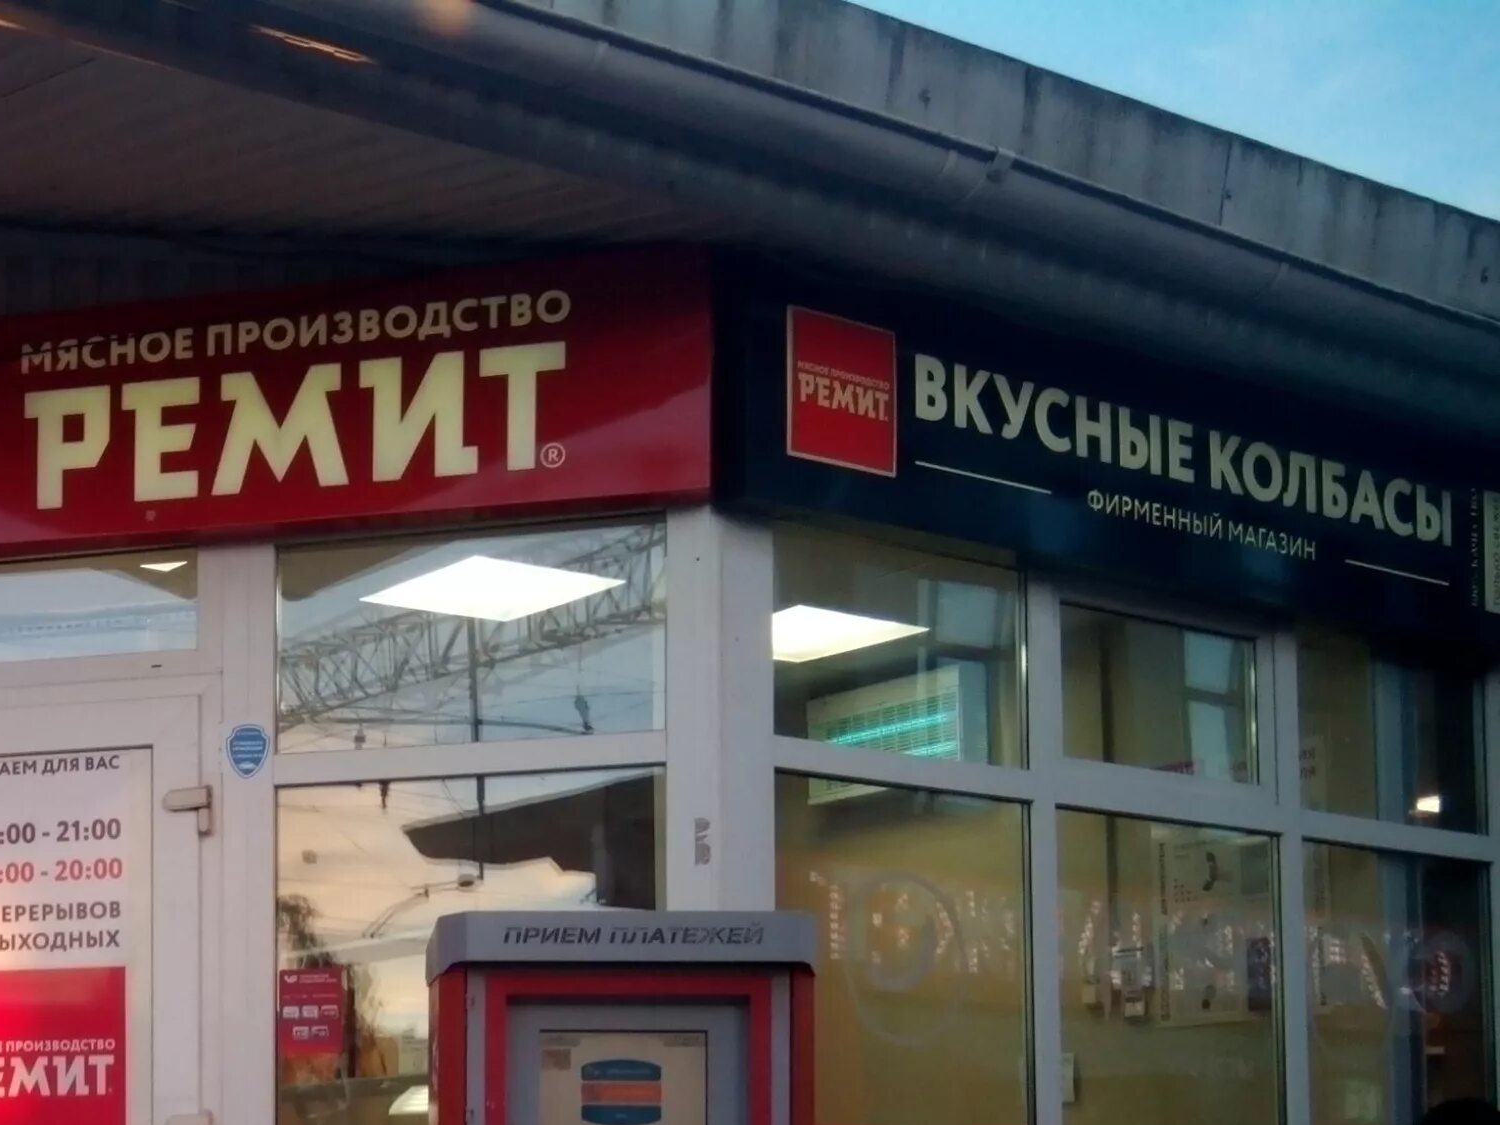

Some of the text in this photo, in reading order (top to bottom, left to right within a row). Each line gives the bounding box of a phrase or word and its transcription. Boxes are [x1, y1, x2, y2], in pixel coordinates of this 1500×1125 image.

[21, 289, 572, 376] МЯСНОЕ ПРОИЗВОДСТВО
[24, 341, 566, 510] РЕМИТ
[797, 372, 889, 421] РЕМИТ
[913, 352, 1197, 486] ВКУСНЫЕ
[1208, 428, 1453, 547] КОЛБАСЫ
[1086, 488, 1318, 562] ФИРМЕННЫЙ МАГАЗИН
[41, 756, 80, 774] ДЛЯ
[84, 755, 120, 772] ВАС
[503, 922, 765, 945] ПРИЕМ ПЛАТЕЖЕЙ
[5, 1038, 116, 1053] ПРОИЗВОДСТВО
